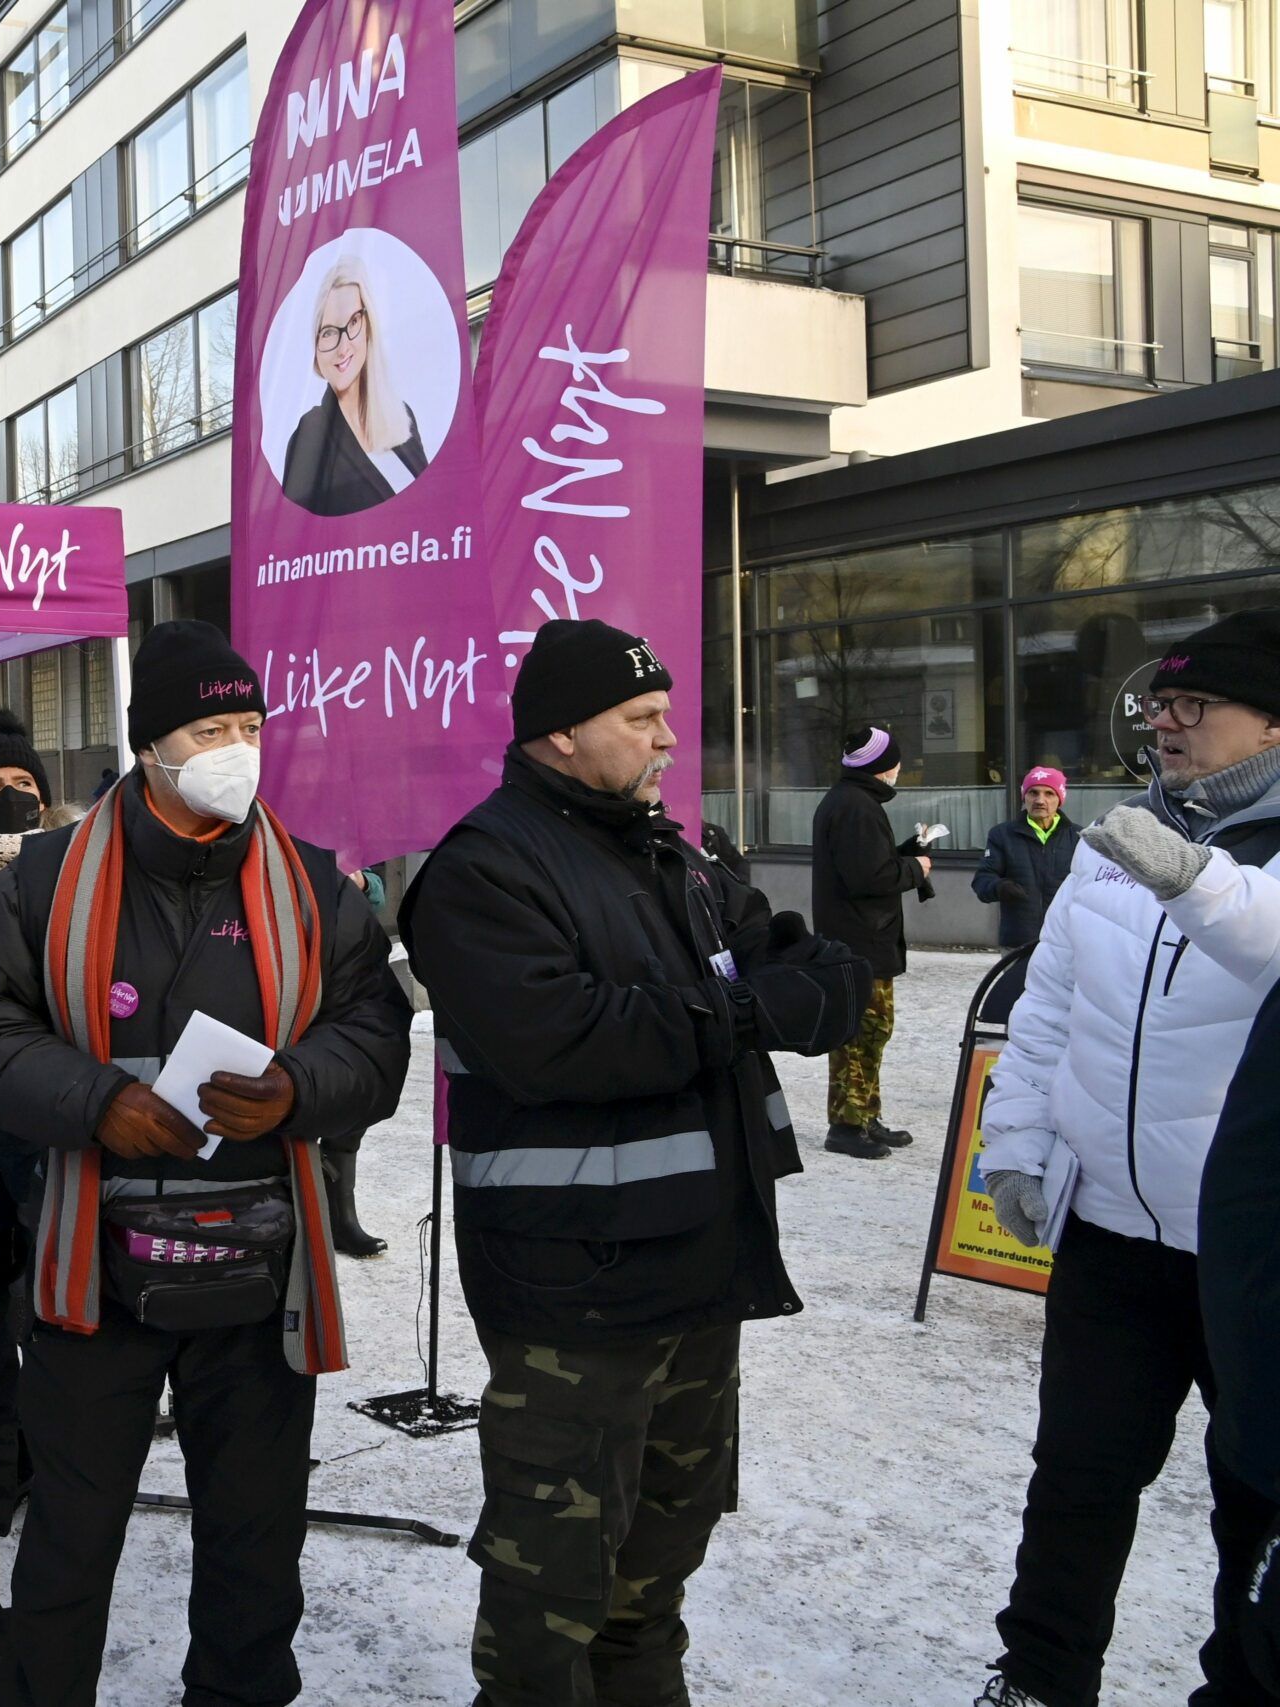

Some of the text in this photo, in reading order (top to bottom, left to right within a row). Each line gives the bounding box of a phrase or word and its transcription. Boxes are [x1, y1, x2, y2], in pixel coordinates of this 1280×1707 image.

[287, 33, 406, 160] NINA
[520, 323, 667, 518] Nyt
[257, 525, 472, 588] ninanummela.fi
[200, 679, 255, 701] Liike Nyt
[264, 636, 488, 738] Liike Nyt
[1094, 866, 1124, 887] Liike
[978, 1221, 993, 1234] La
